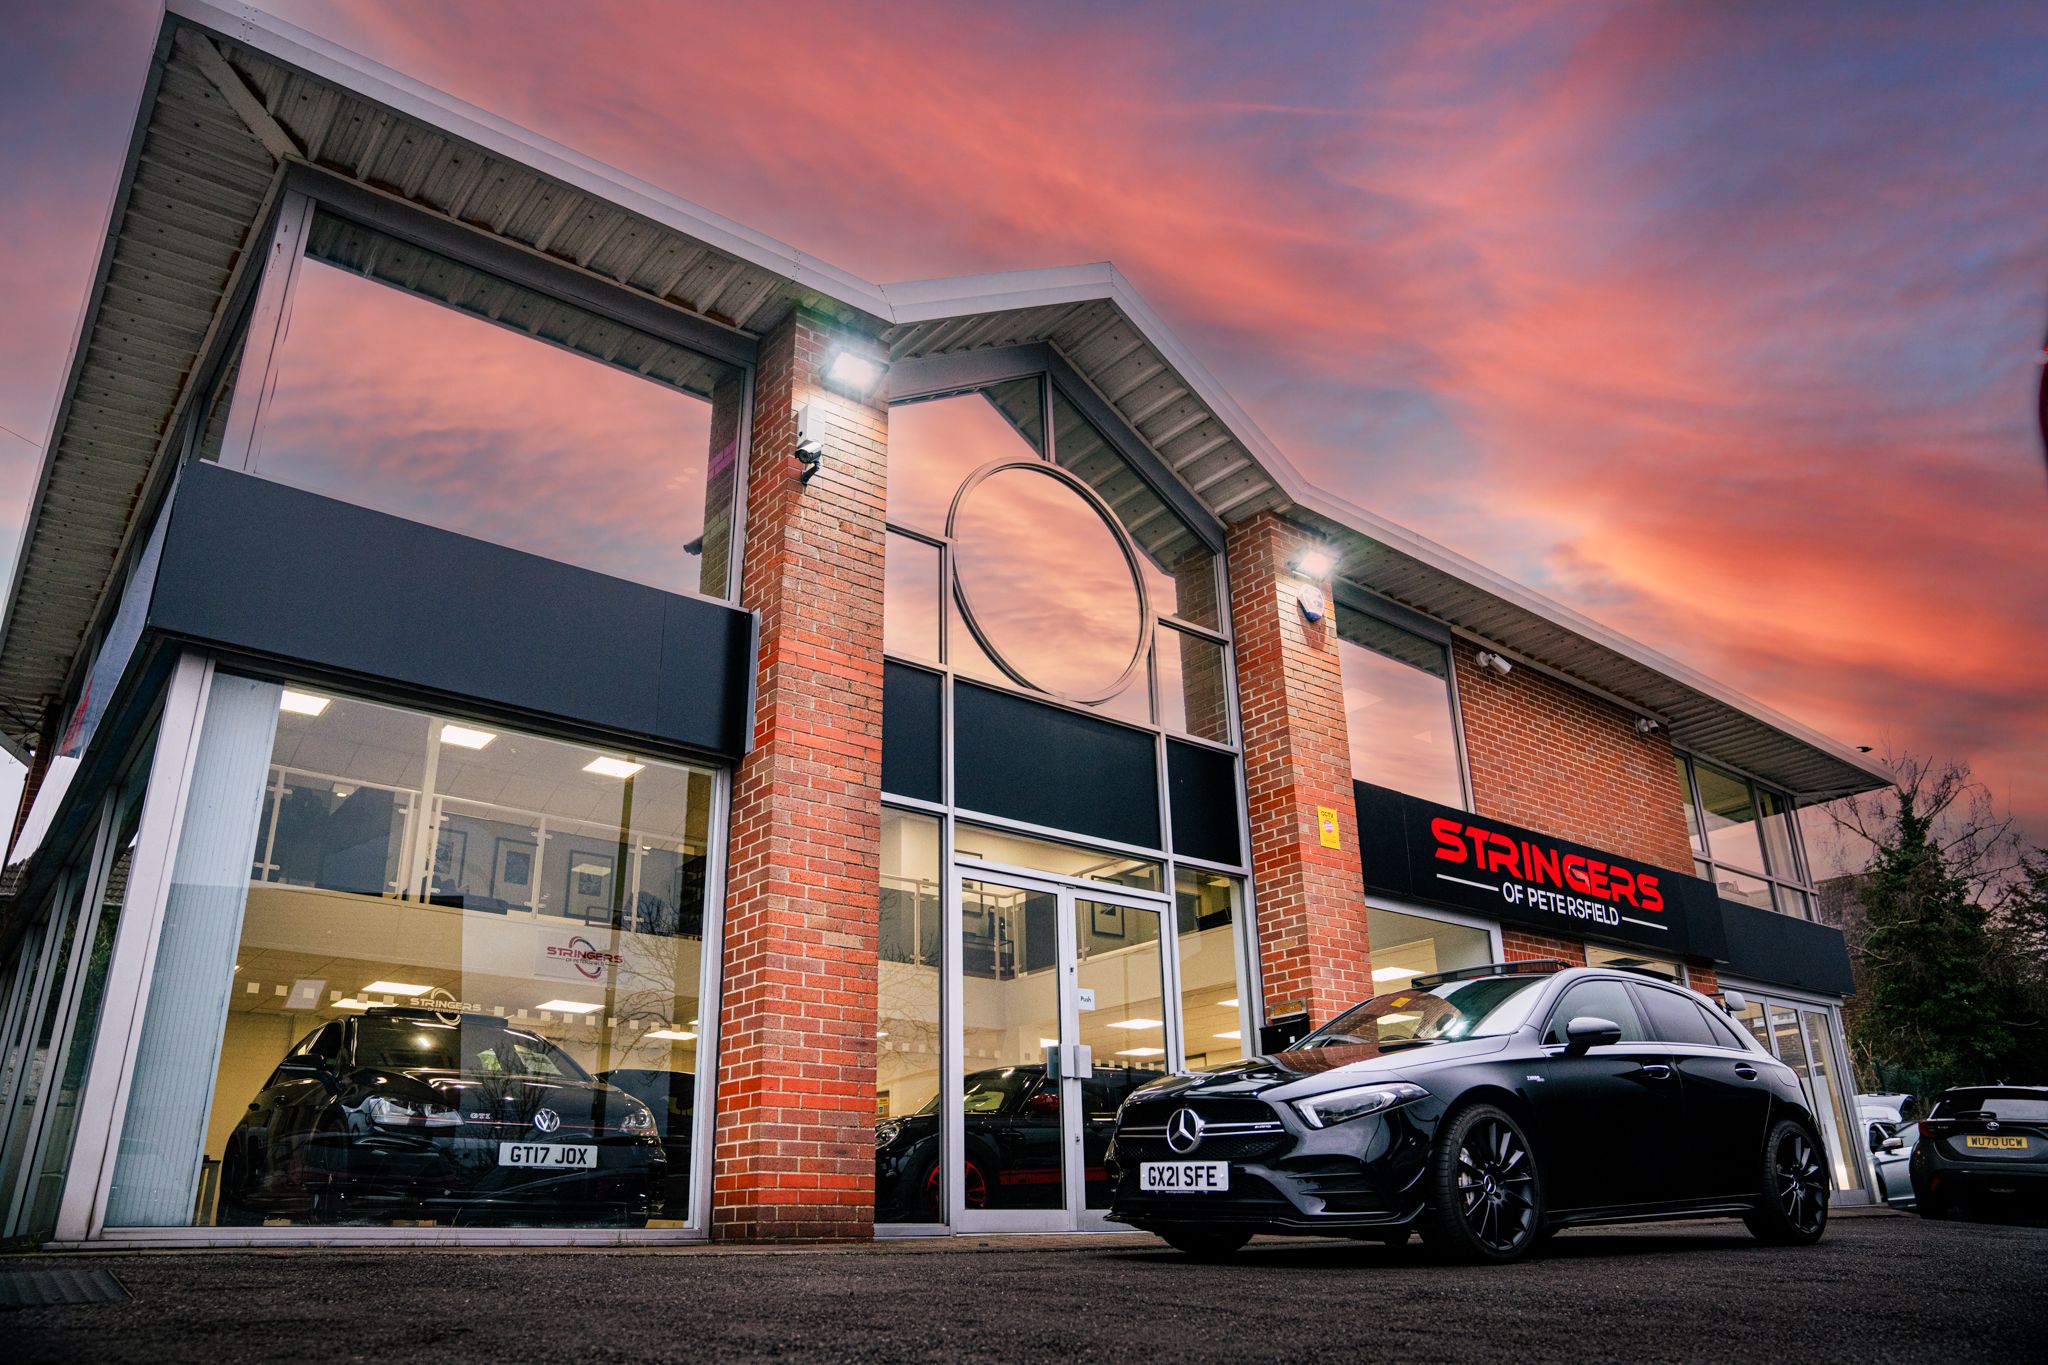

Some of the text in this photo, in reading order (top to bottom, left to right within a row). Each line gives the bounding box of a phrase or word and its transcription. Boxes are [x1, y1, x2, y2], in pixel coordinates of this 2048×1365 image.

[1430, 816, 1664, 913] STRINGERS
[1502, 881, 1619, 926] OF PETERSFIELD
[546, 946, 624, 964] STRINGERS
[410, 997, 482, 1012] STRINGERS
[1080, 995, 1092, 1003] Push
[470, 1112, 491, 1120] GTI
[1971, 1137, 2023, 1147] WU70 UCW
[510, 1145, 588, 1165] GT17 JOX
[1148, 1165, 1218, 1187] GX21 SFE
